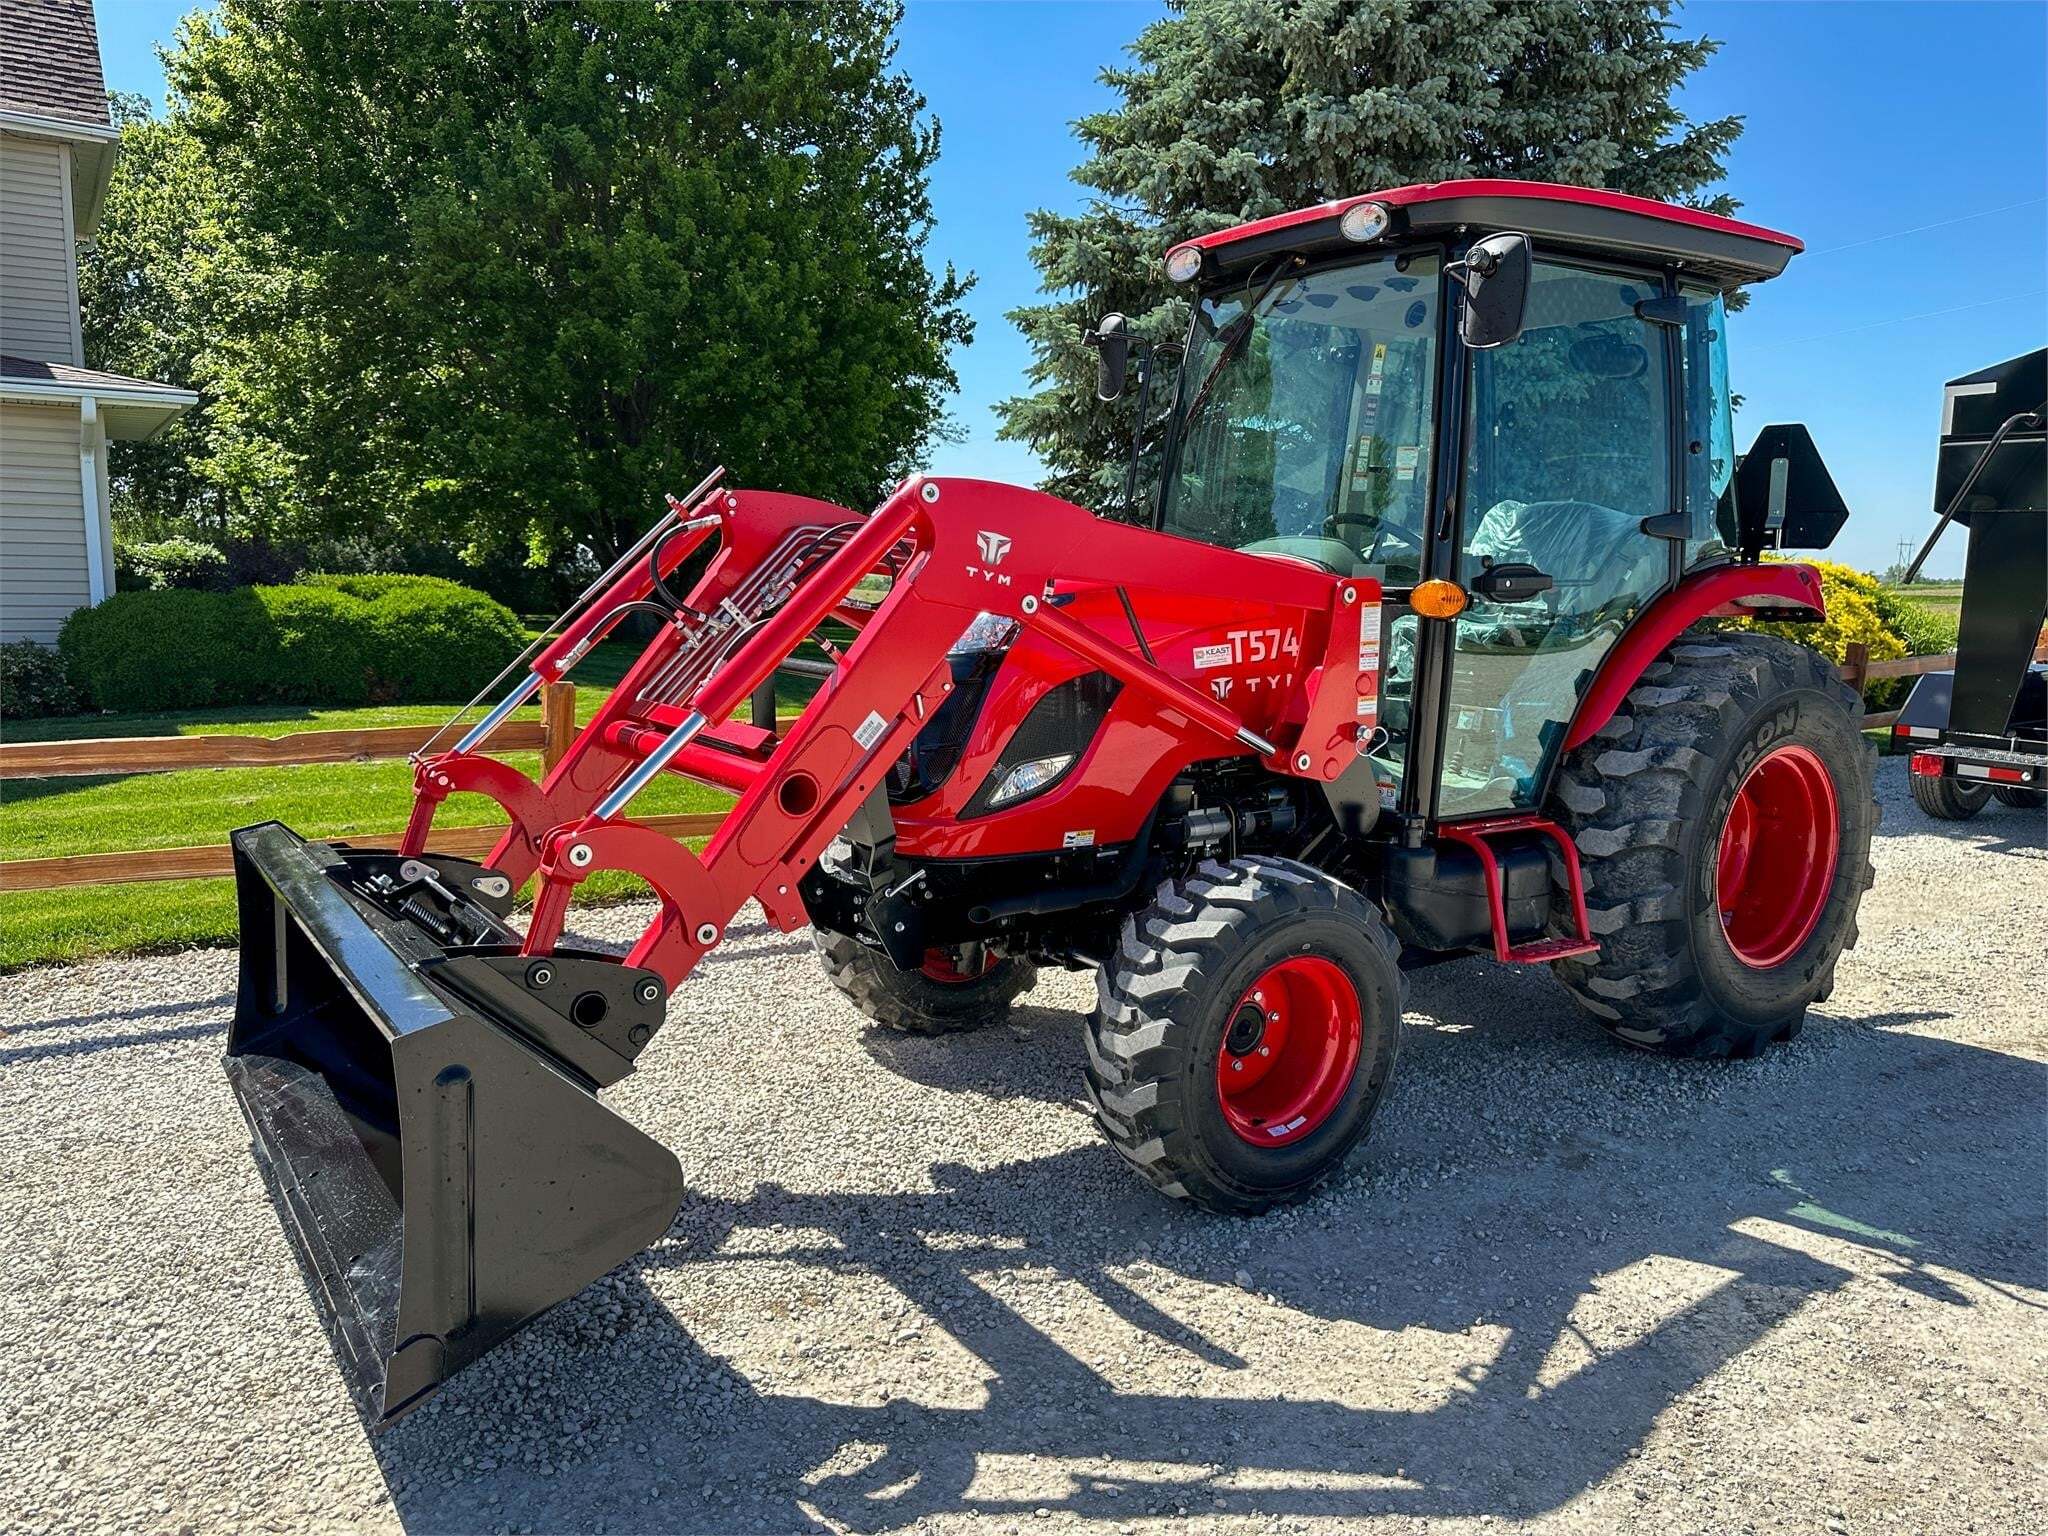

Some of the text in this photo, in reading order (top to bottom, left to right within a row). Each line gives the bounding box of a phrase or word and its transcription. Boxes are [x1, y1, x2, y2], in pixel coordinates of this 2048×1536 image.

[965, 565, 1012, 587] TYM
[1205, 646, 1230, 656] KEAST
[1226, 627, 1300, 664] T574
